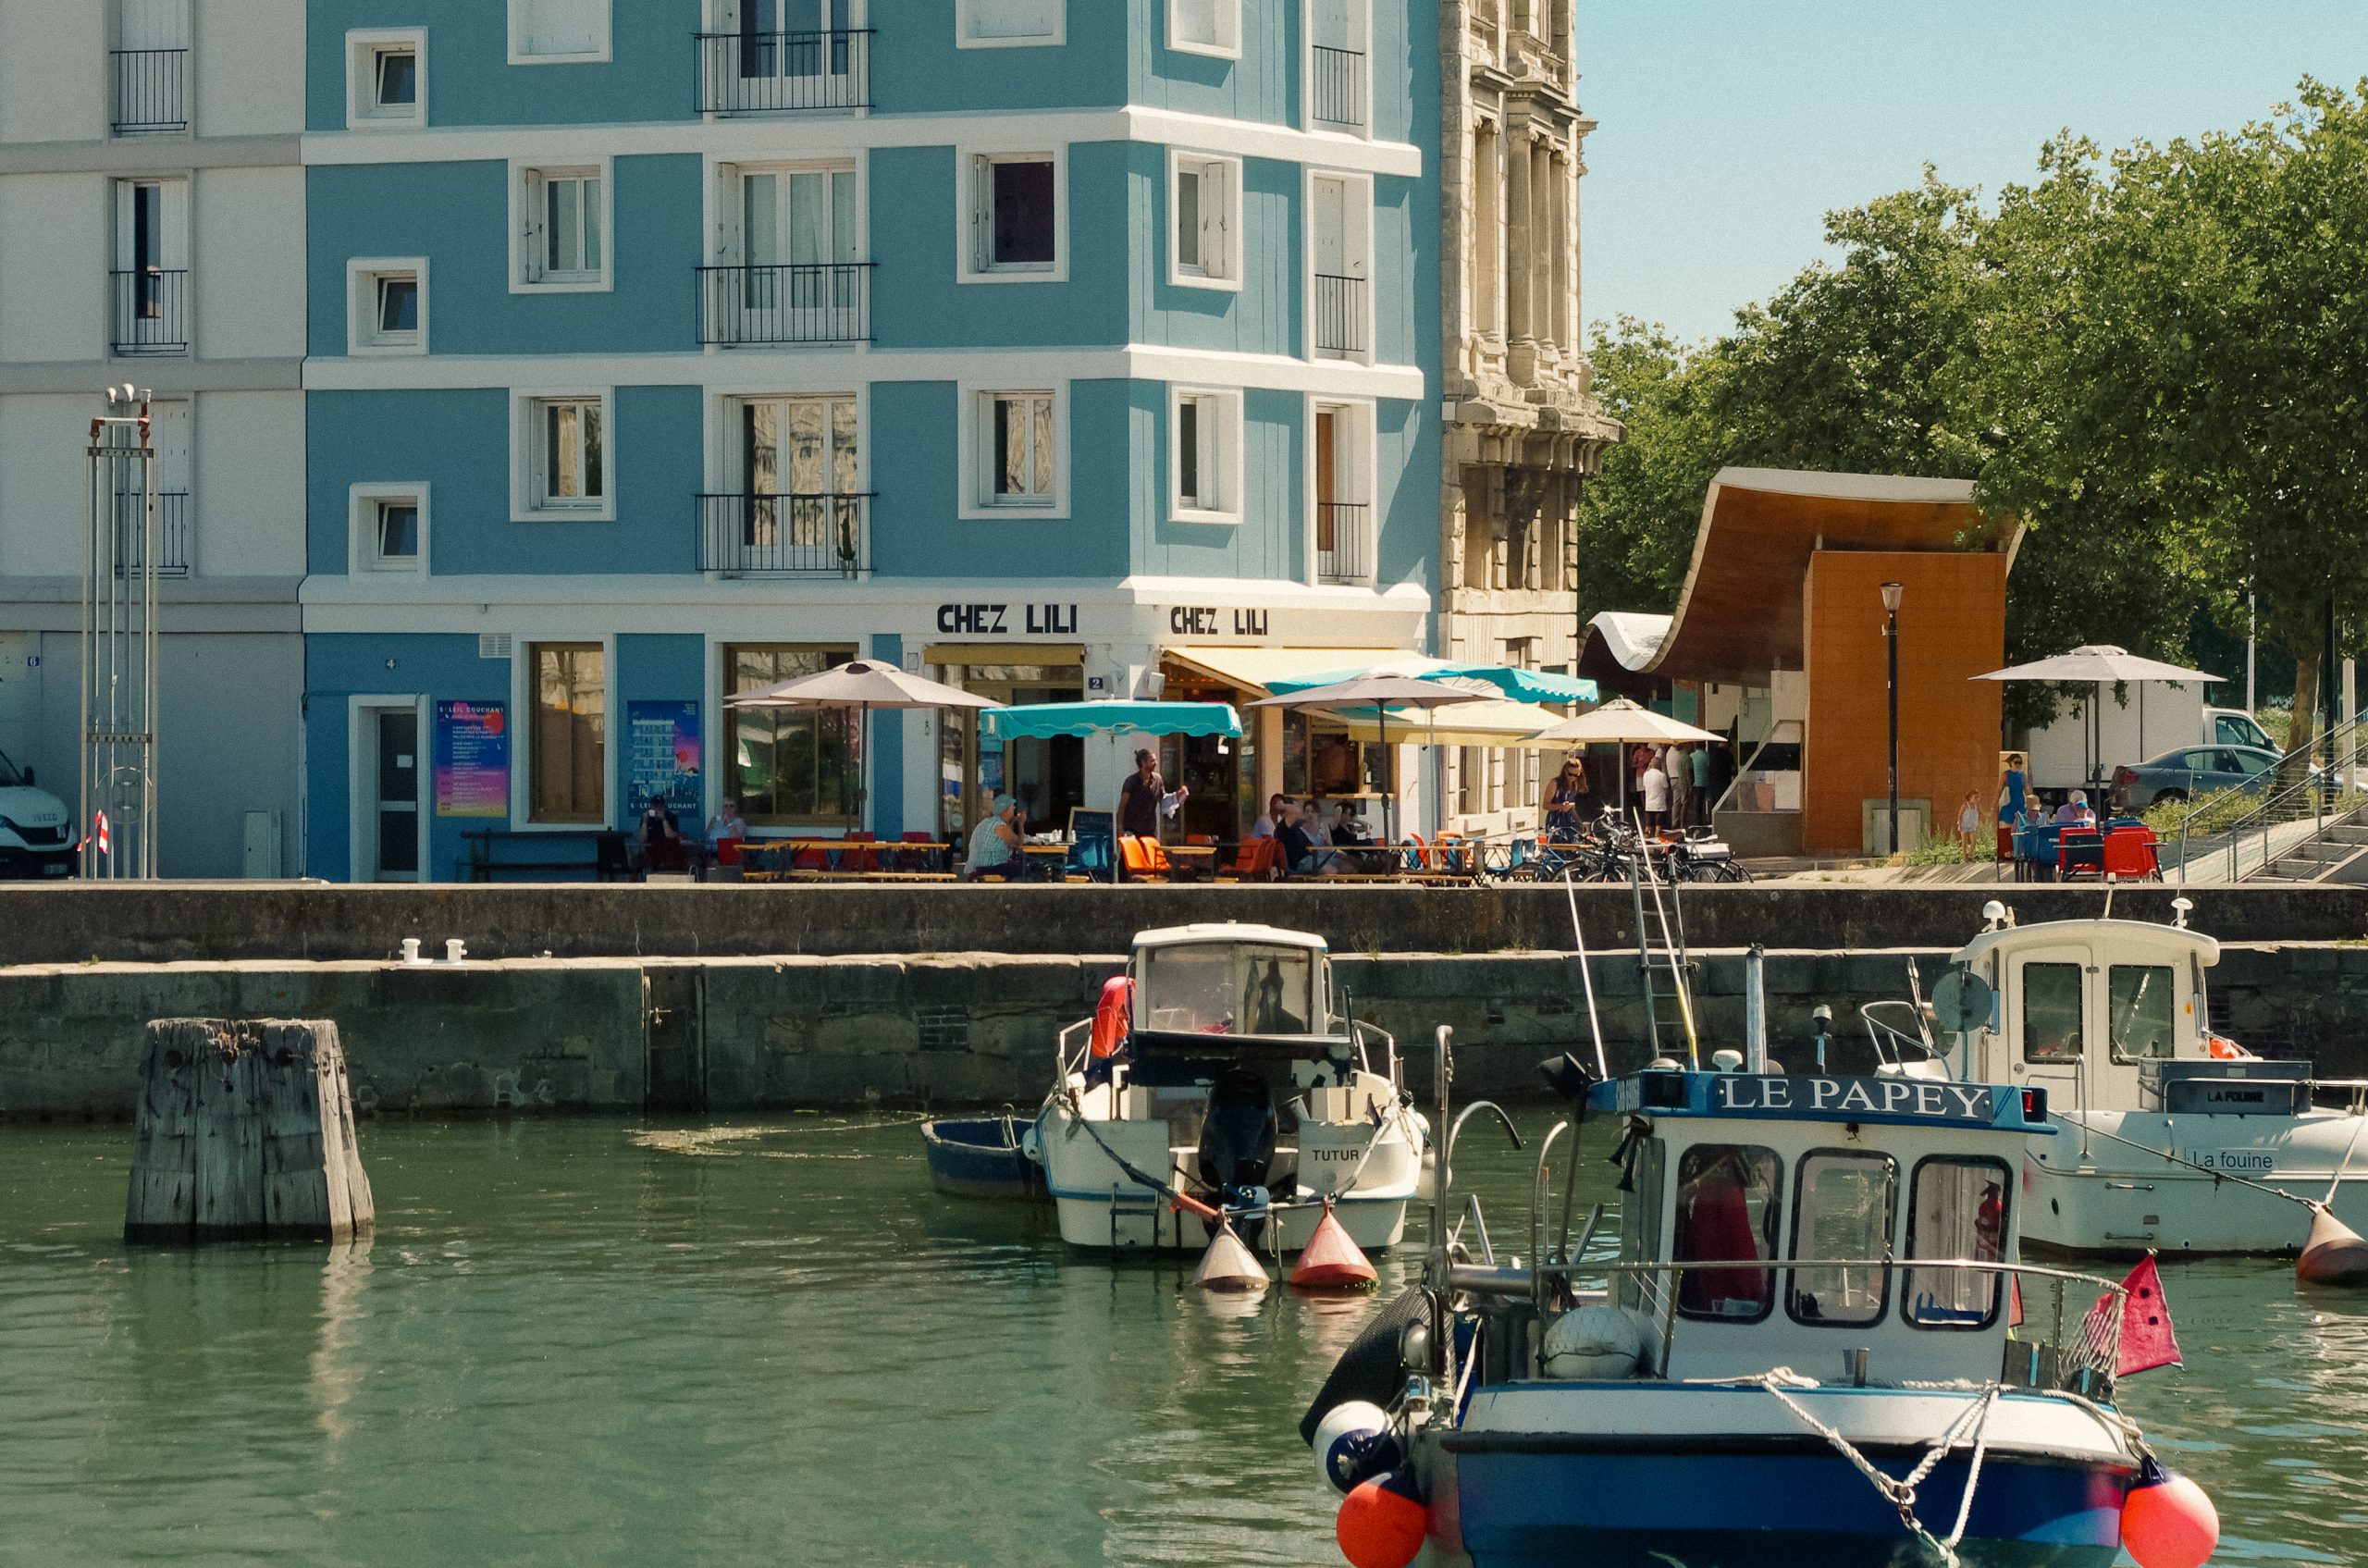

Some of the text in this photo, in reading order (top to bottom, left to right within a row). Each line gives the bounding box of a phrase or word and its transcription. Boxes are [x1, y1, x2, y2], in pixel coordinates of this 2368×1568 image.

[937, 604, 1078, 634] CHEZ LILI
[1170, 606, 1268, 636] CHEZ LILI
[1092, 678, 1101, 689] 2
[1720, 1078, 1991, 1118] LE PAPEY
[2207, 1092, 2264, 1103] LA FOUINE
[1312, 1149, 1360, 1161] TUTUR
[2193, 1151, 2273, 1168] La fouine
